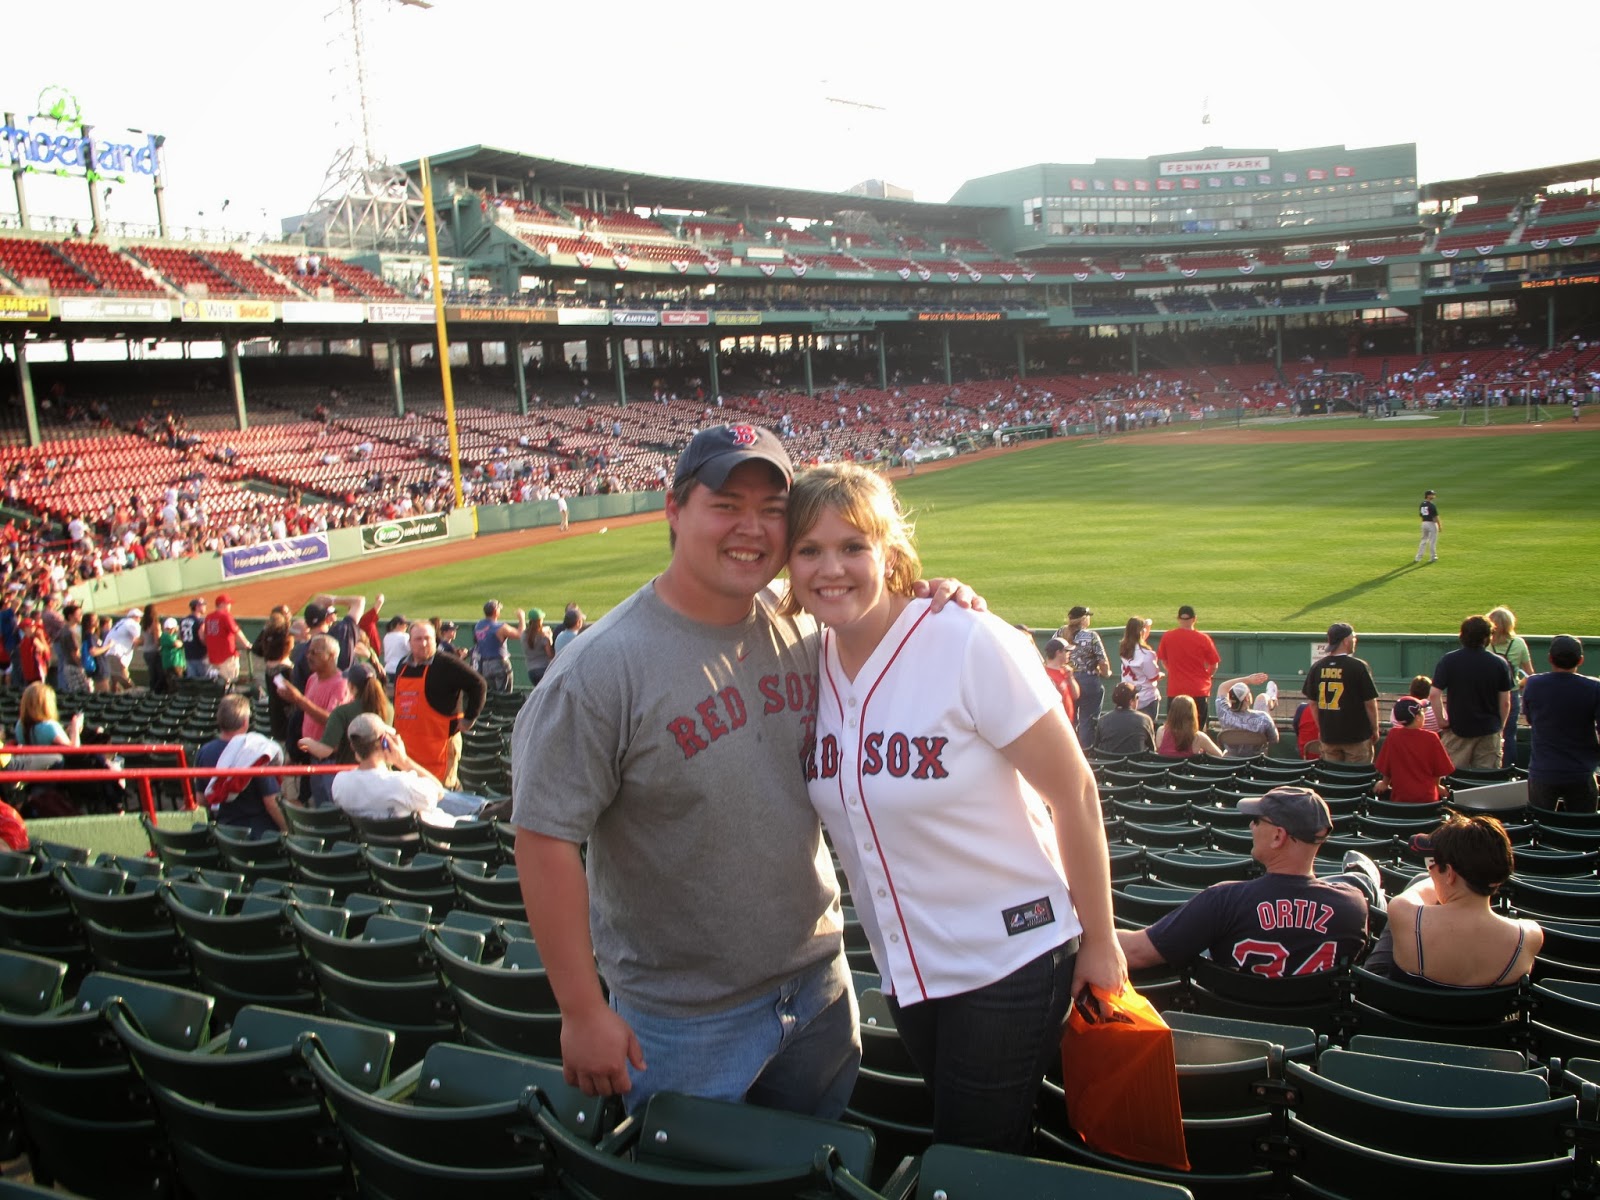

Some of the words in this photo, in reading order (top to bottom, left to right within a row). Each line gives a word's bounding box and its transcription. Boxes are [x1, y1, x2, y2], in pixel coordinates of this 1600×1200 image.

[1167, 162, 1220, 173] FENWAY
[1227, 159, 1262, 170] PARK
[1521, 280, 1554, 289] Welcome
[1569, 275, 1600, 285] Fenway
[460, 308, 492, 320] Welcome
[494, 308, 503, 320] to
[505, 308, 530, 323] Fenway
[531, 308, 547, 320] Park
[729, 424, 758, 446] B
[1318, 682, 1344, 710] 17
[666, 686, 748, 760] RED
[862, 730, 950, 780] SOX
[1256, 898, 1335, 934] ORTIZ
